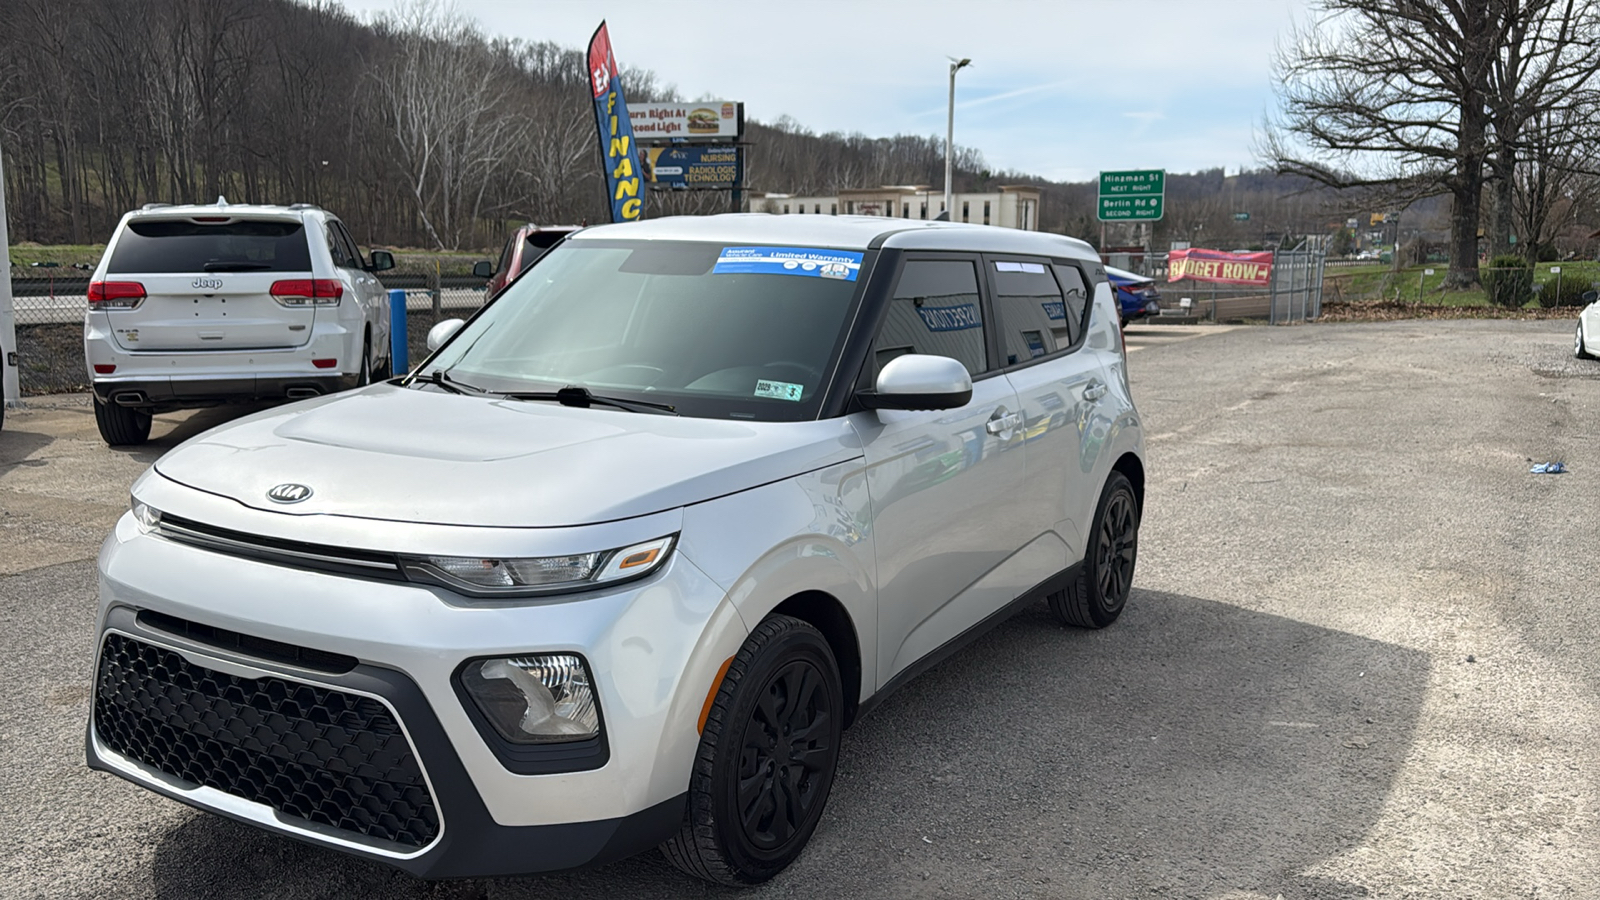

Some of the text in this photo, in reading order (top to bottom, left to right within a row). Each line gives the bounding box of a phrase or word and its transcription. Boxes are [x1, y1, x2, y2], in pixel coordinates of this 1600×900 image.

[649, 108, 674, 120] Right
[675, 109, 686, 118] At
[633, 122, 681, 133] cond Light
[608, 91, 642, 220] FINANC
[701, 153, 736, 162] NURSING
[689, 165, 736, 174] RADIOLOGIC
[684, 173, 737, 182] TECHNOLOGY
[1104, 173, 1159, 183] Hinzman St
[1103, 200, 1131, 208] Berlin
[1135, 199, 1146, 207] Rd
[808, 254, 855, 263] Warranty
[1222, 263, 1259, 280] ROW
[192, 278, 223, 289] Jeep
[789, 387, 796, 397] 3
[271, 484, 304, 499] KIA
